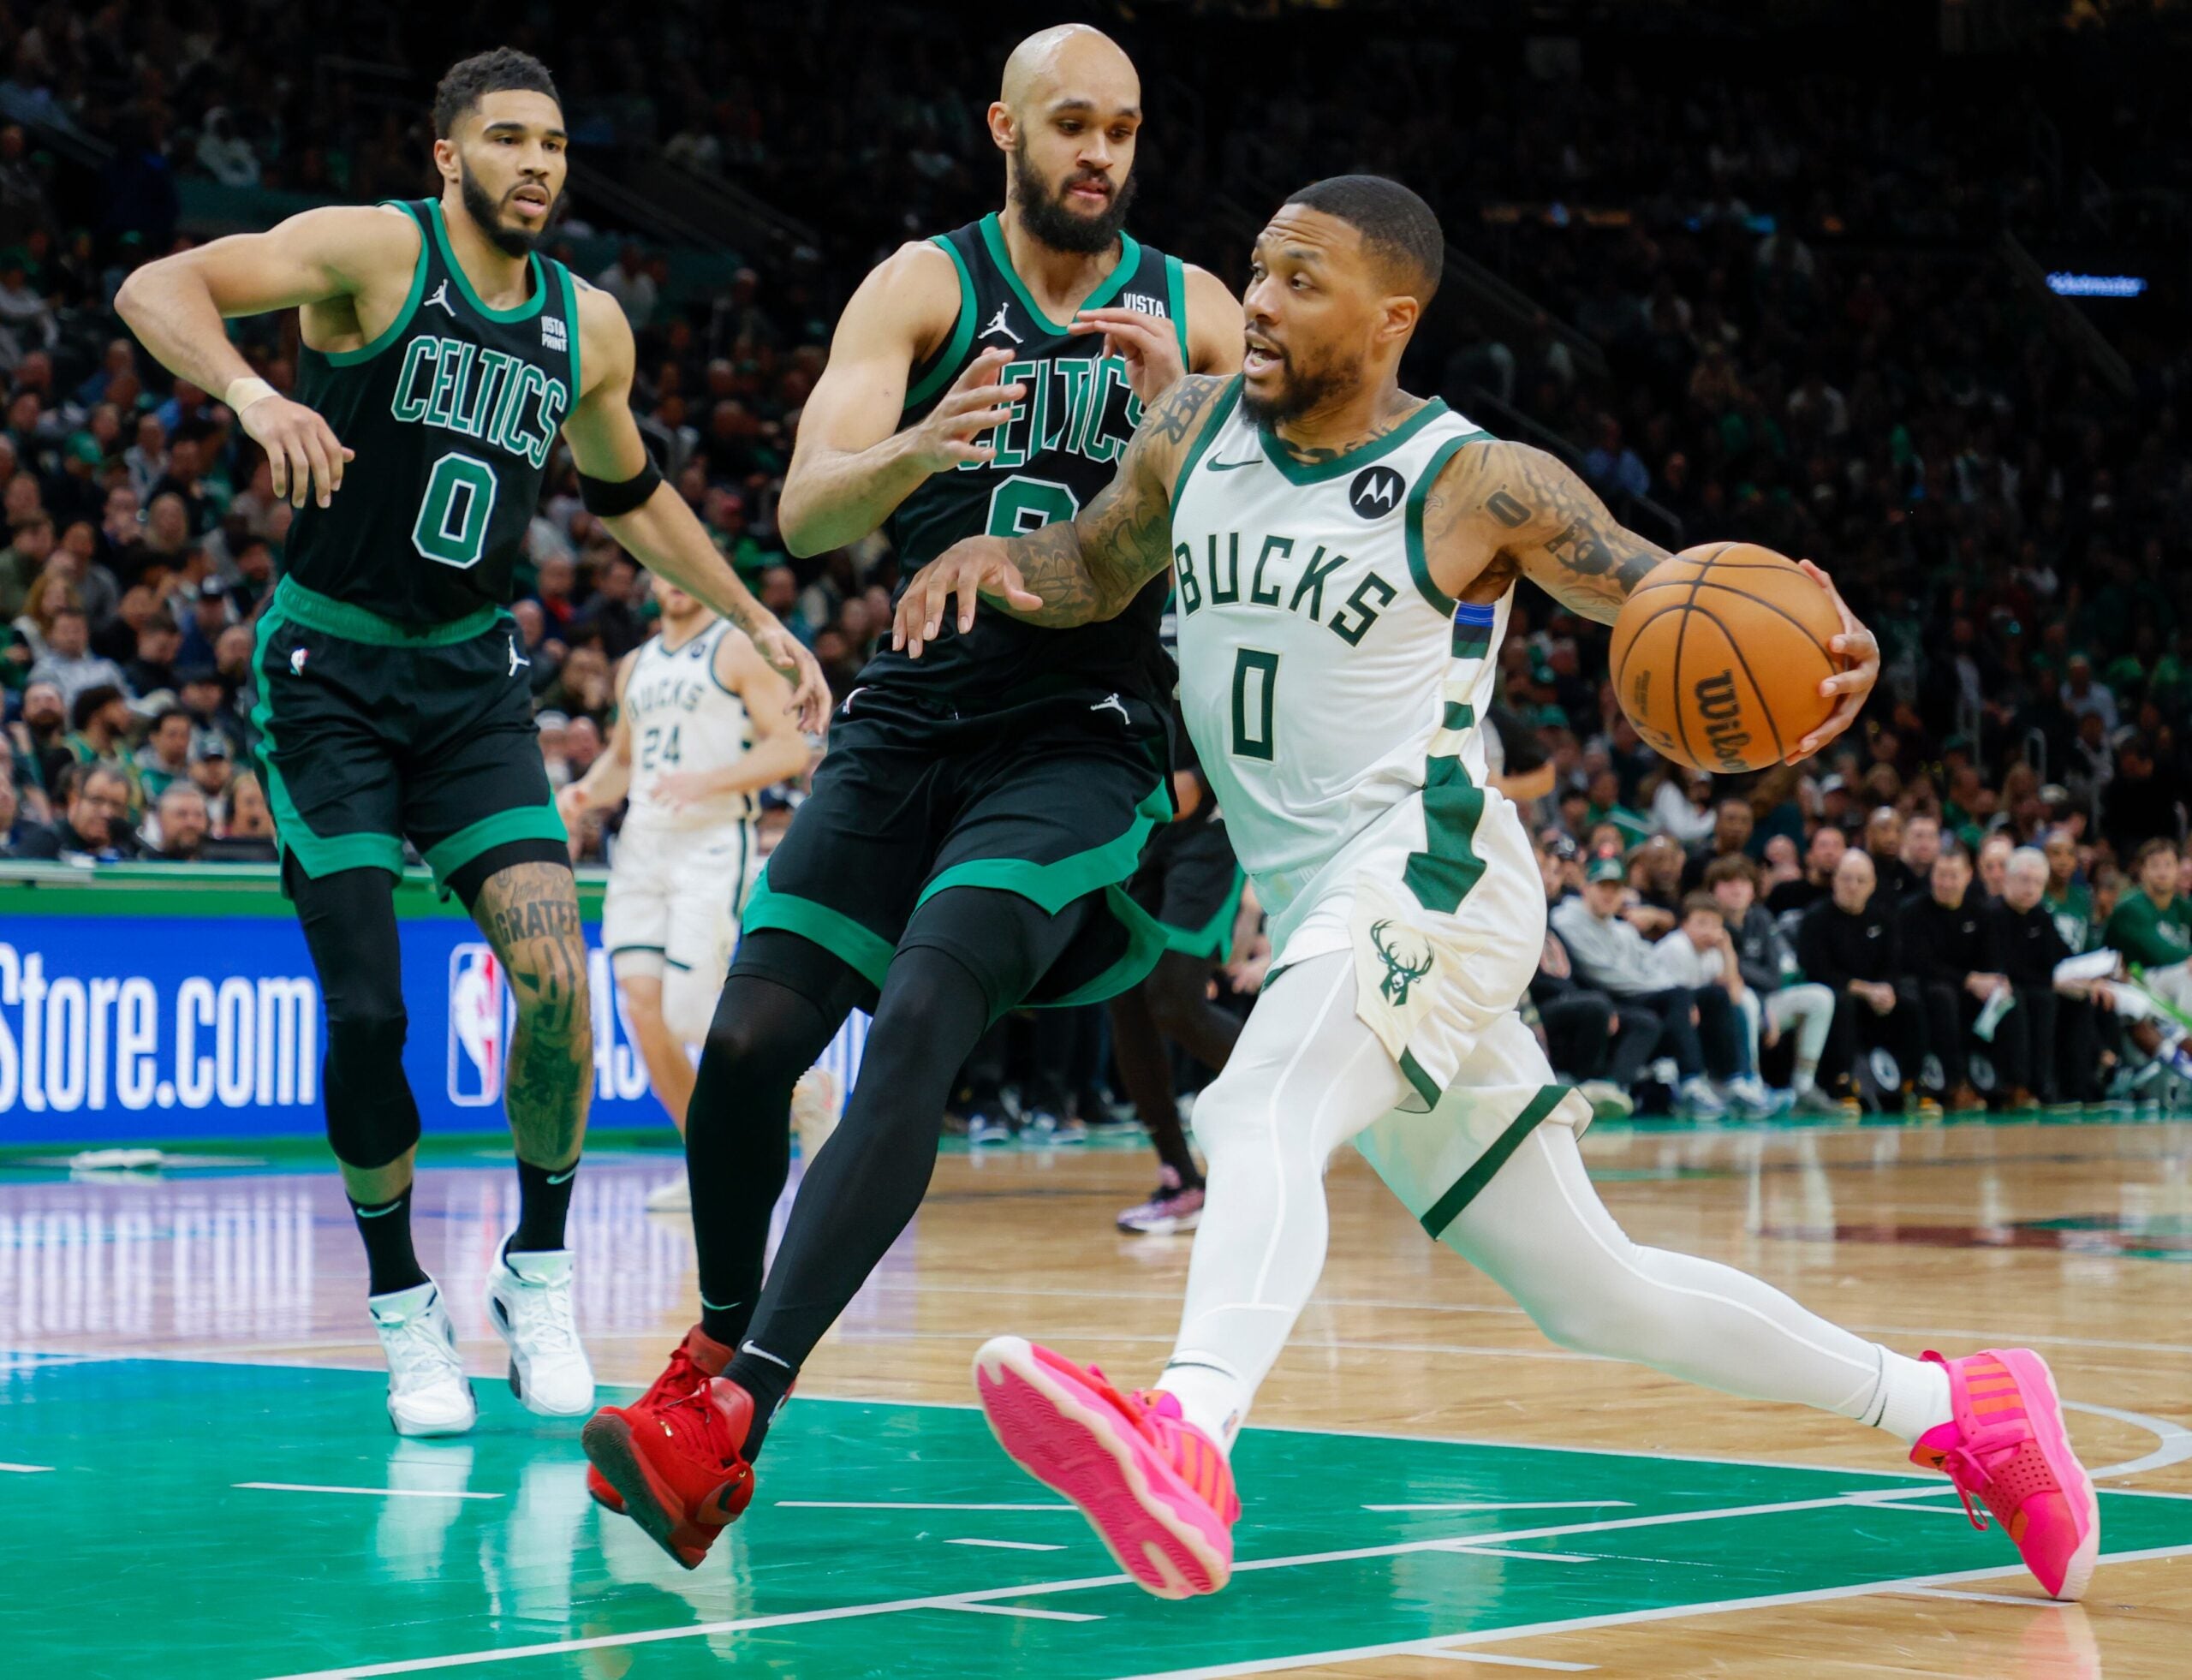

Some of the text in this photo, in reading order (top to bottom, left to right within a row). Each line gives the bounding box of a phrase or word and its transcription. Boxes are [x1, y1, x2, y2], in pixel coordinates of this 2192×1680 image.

[540, 315, 567, 338] VISTA
[541, 332, 568, 353] PRINT
[1123, 292, 1166, 319] VISTA
[390, 335, 567, 470] CELTICS
[957, 354, 1145, 472] ELTIC
[412, 451, 497, 569] 0
[1173, 531, 1398, 648] BUCKS
[626, 677, 706, 723] BUCKS
[643, 725, 681, 771] 24
[1230, 646, 1281, 764] 0
[1695, 668, 1753, 772] Wilso
